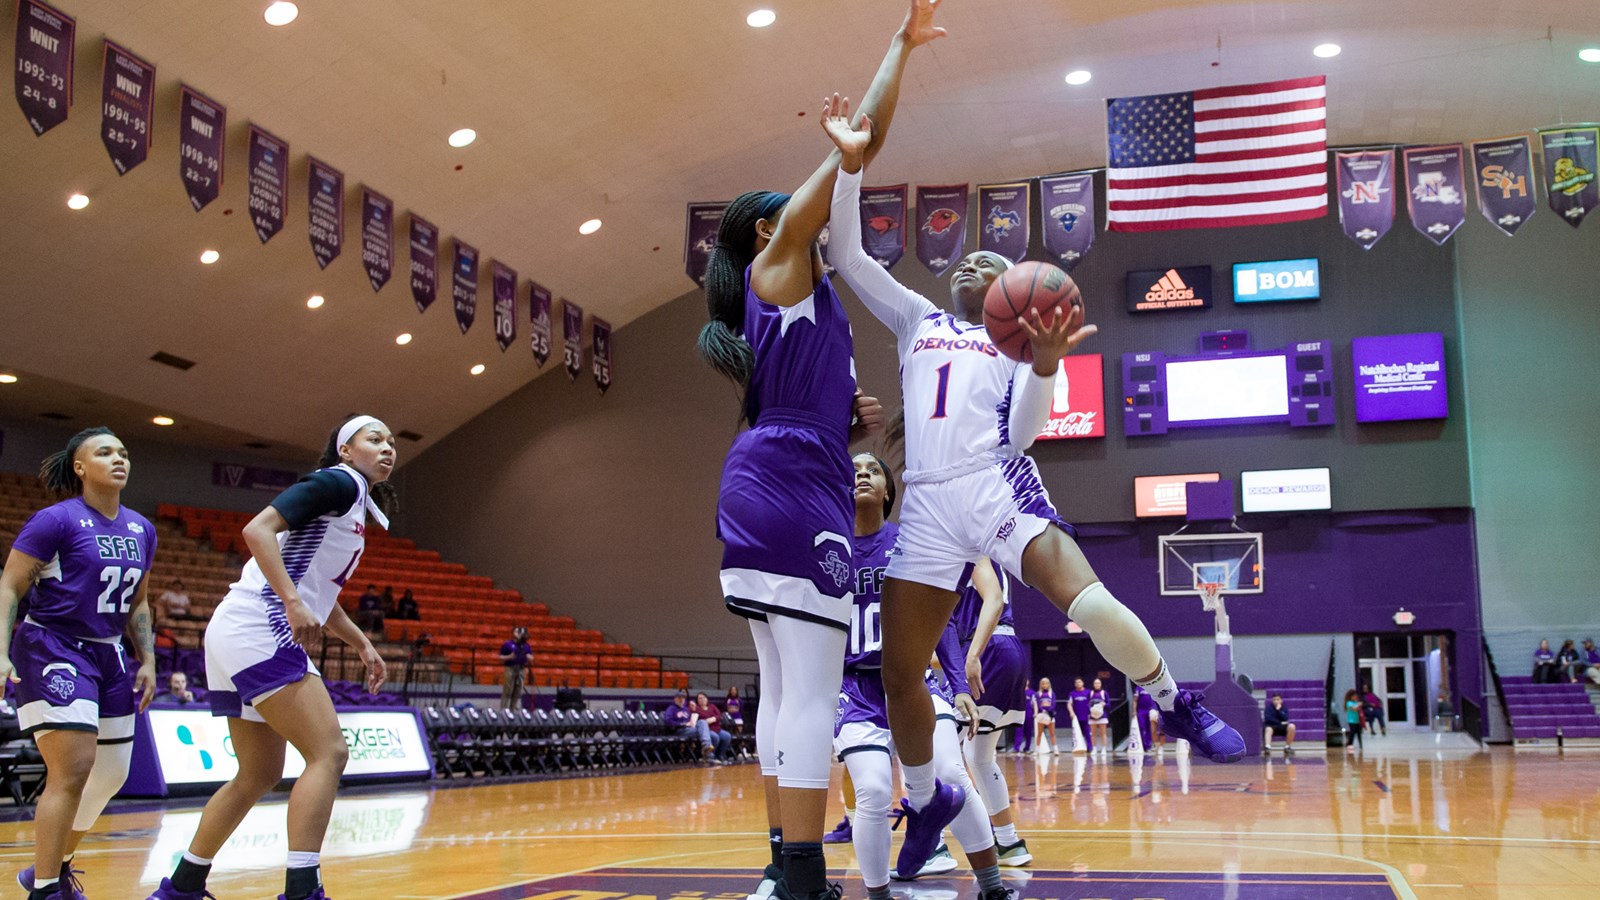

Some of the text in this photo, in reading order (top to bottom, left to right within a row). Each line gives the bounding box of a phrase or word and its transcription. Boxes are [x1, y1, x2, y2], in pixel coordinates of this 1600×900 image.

[29, 26, 60, 54] WNIT
[18, 58, 65, 91] 1992-93
[23, 85, 57, 109] 24-8
[116, 73, 142, 99] WNIT
[104, 102, 146, 135] 1994-95
[191, 115, 214, 139] WNIT
[108, 128, 138, 150] 25-7
[181, 143, 219, 172] 1998-99
[186, 167, 211, 187] 22-7
[1352, 182, 1379, 203] N
[1425, 182, 1439, 197] N
[250, 195, 281, 219] 2001-02
[1258, 269, 1315, 290] BOM
[1145, 288, 1194, 302] adidas
[496, 315, 513, 338] 10
[530, 333, 548, 355] 25
[911, 337, 999, 359] DEMONS
[1296, 342, 1322, 351] GUEST
[564, 348, 580, 370] 33
[1135, 354, 1151, 362] NSU
[1406, 360, 1440, 374] Regional
[593, 363, 610, 385] 45
[930, 360, 952, 420] 1
[95, 535, 142, 562] SFA
[97, 565, 143, 614] 22
[854, 567, 887, 596] FA
[341, 728, 402, 747] EXGEN
